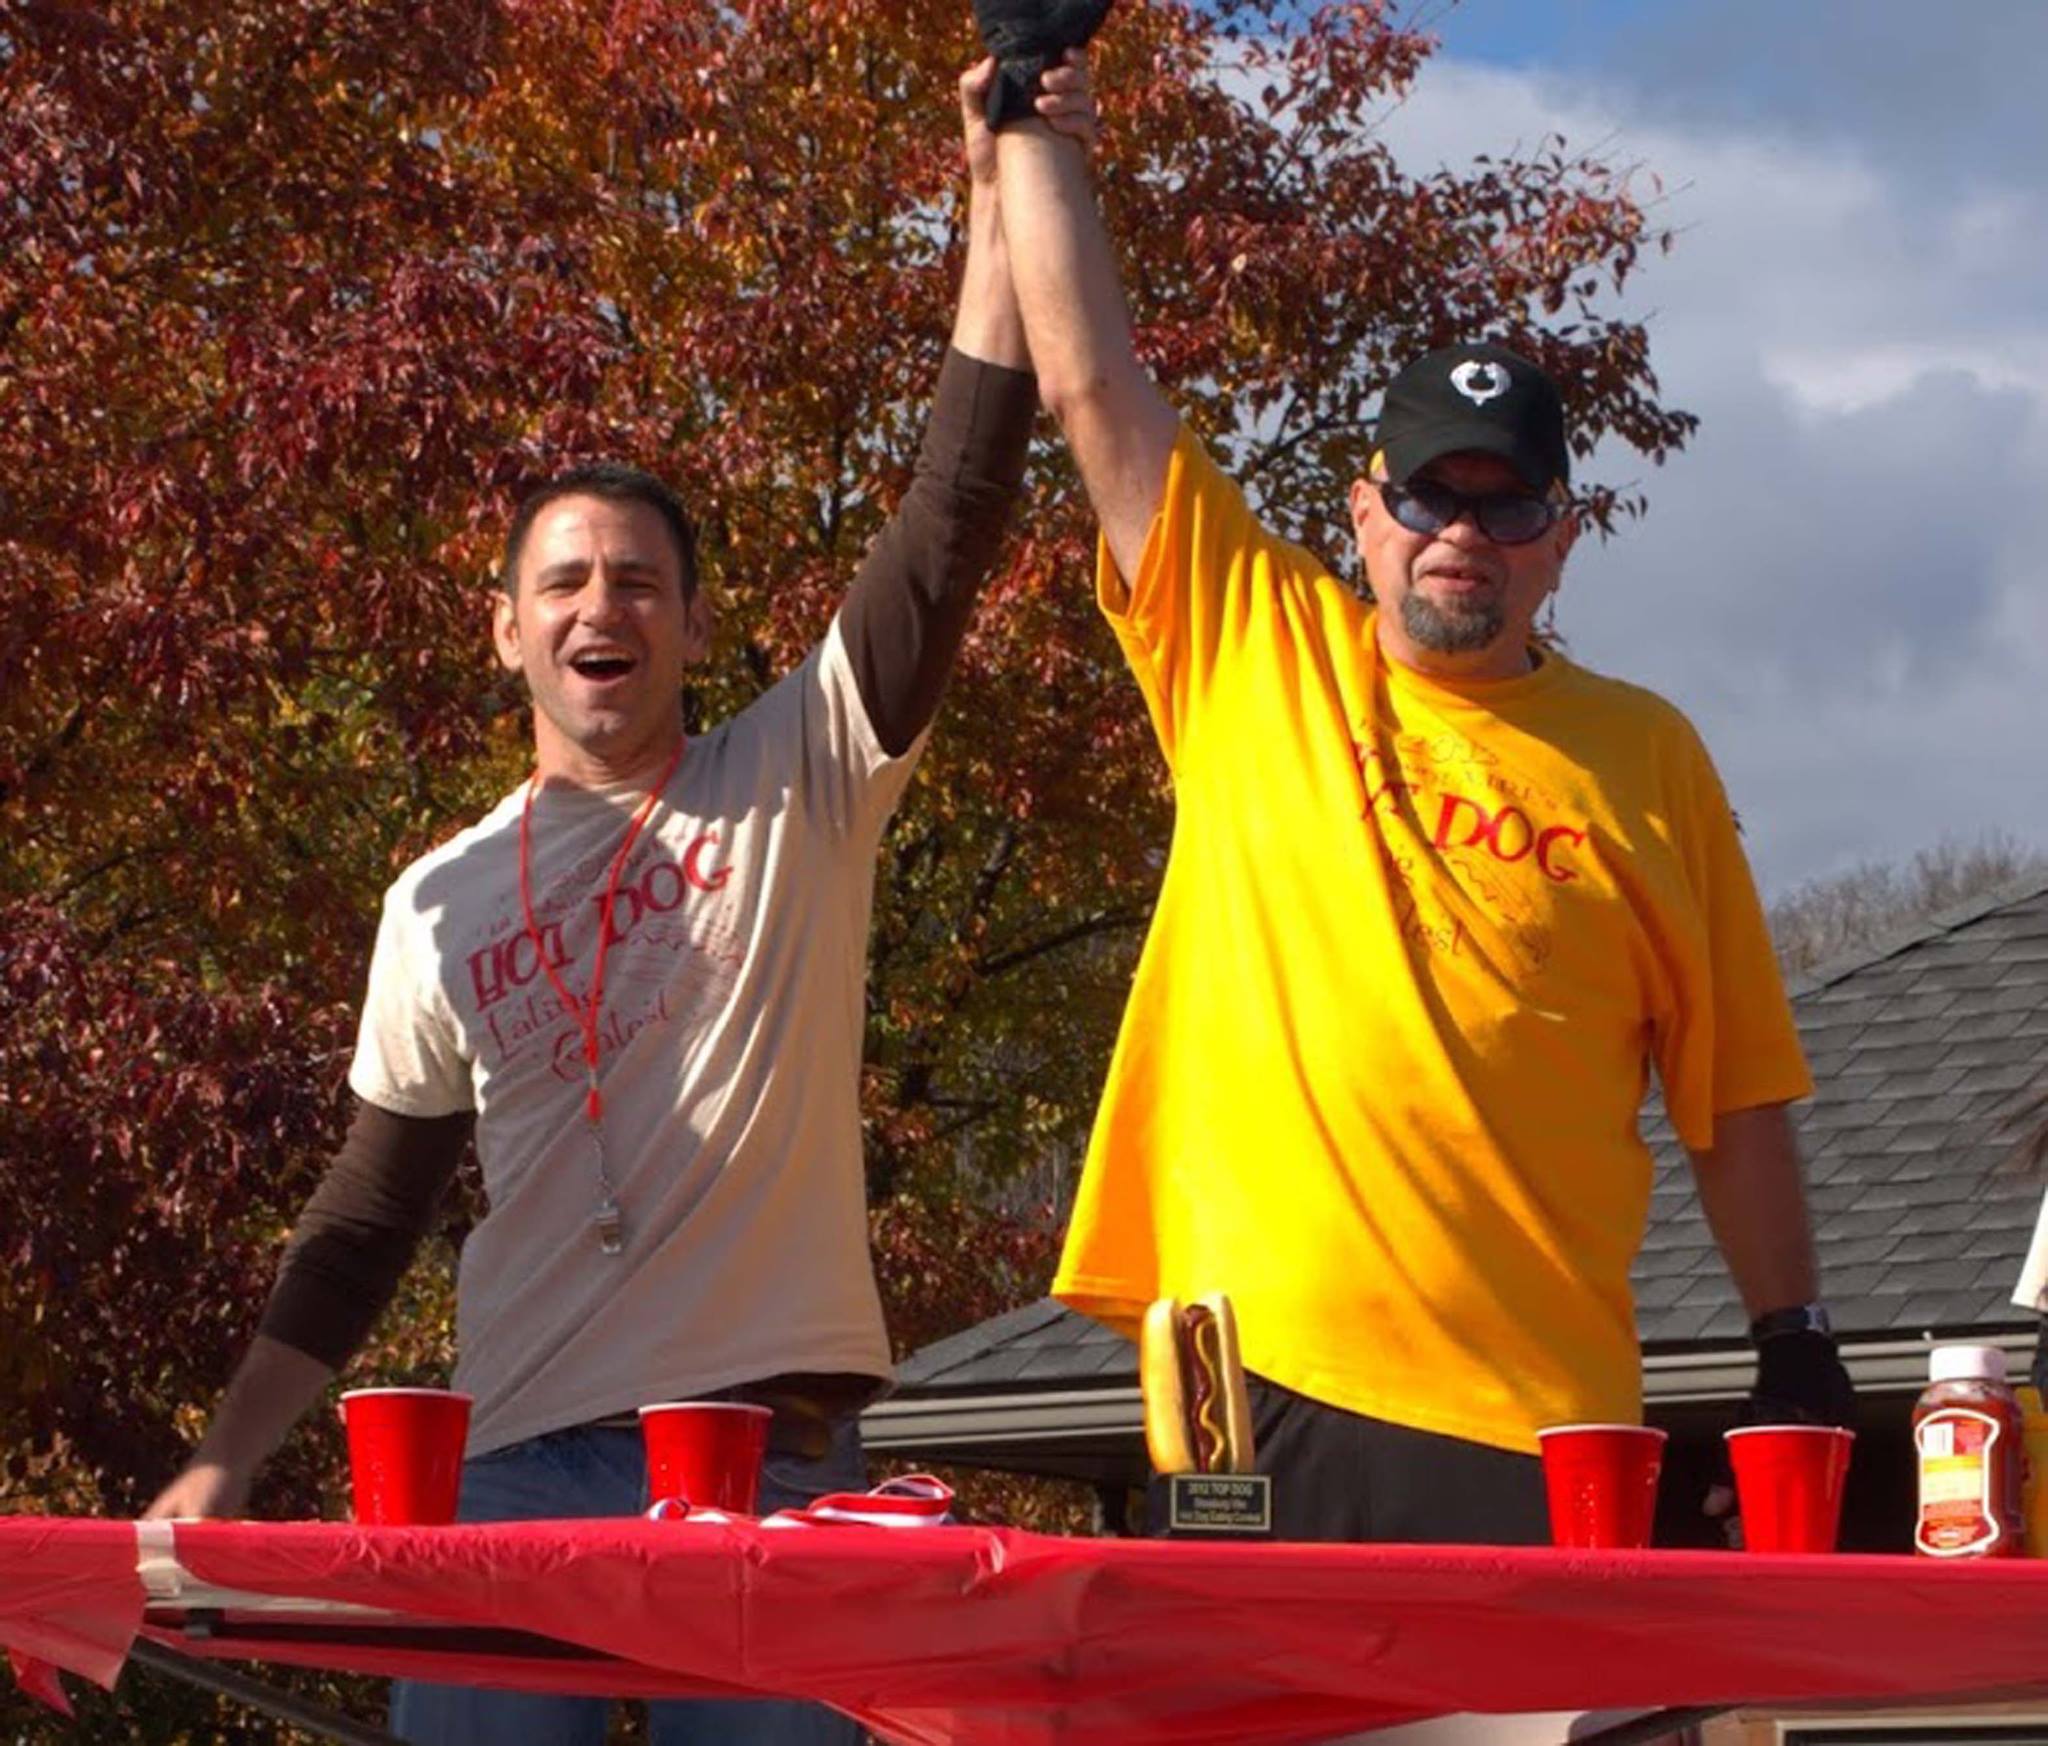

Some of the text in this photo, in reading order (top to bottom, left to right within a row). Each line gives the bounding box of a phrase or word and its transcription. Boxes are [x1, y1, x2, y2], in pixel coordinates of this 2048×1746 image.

[1433, 792, 1585, 883] DOG
[592, 830, 733, 947] DOG
[1211, 1482, 1230, 1497] TOP
[1231, 1483, 1254, 1498] DOG
